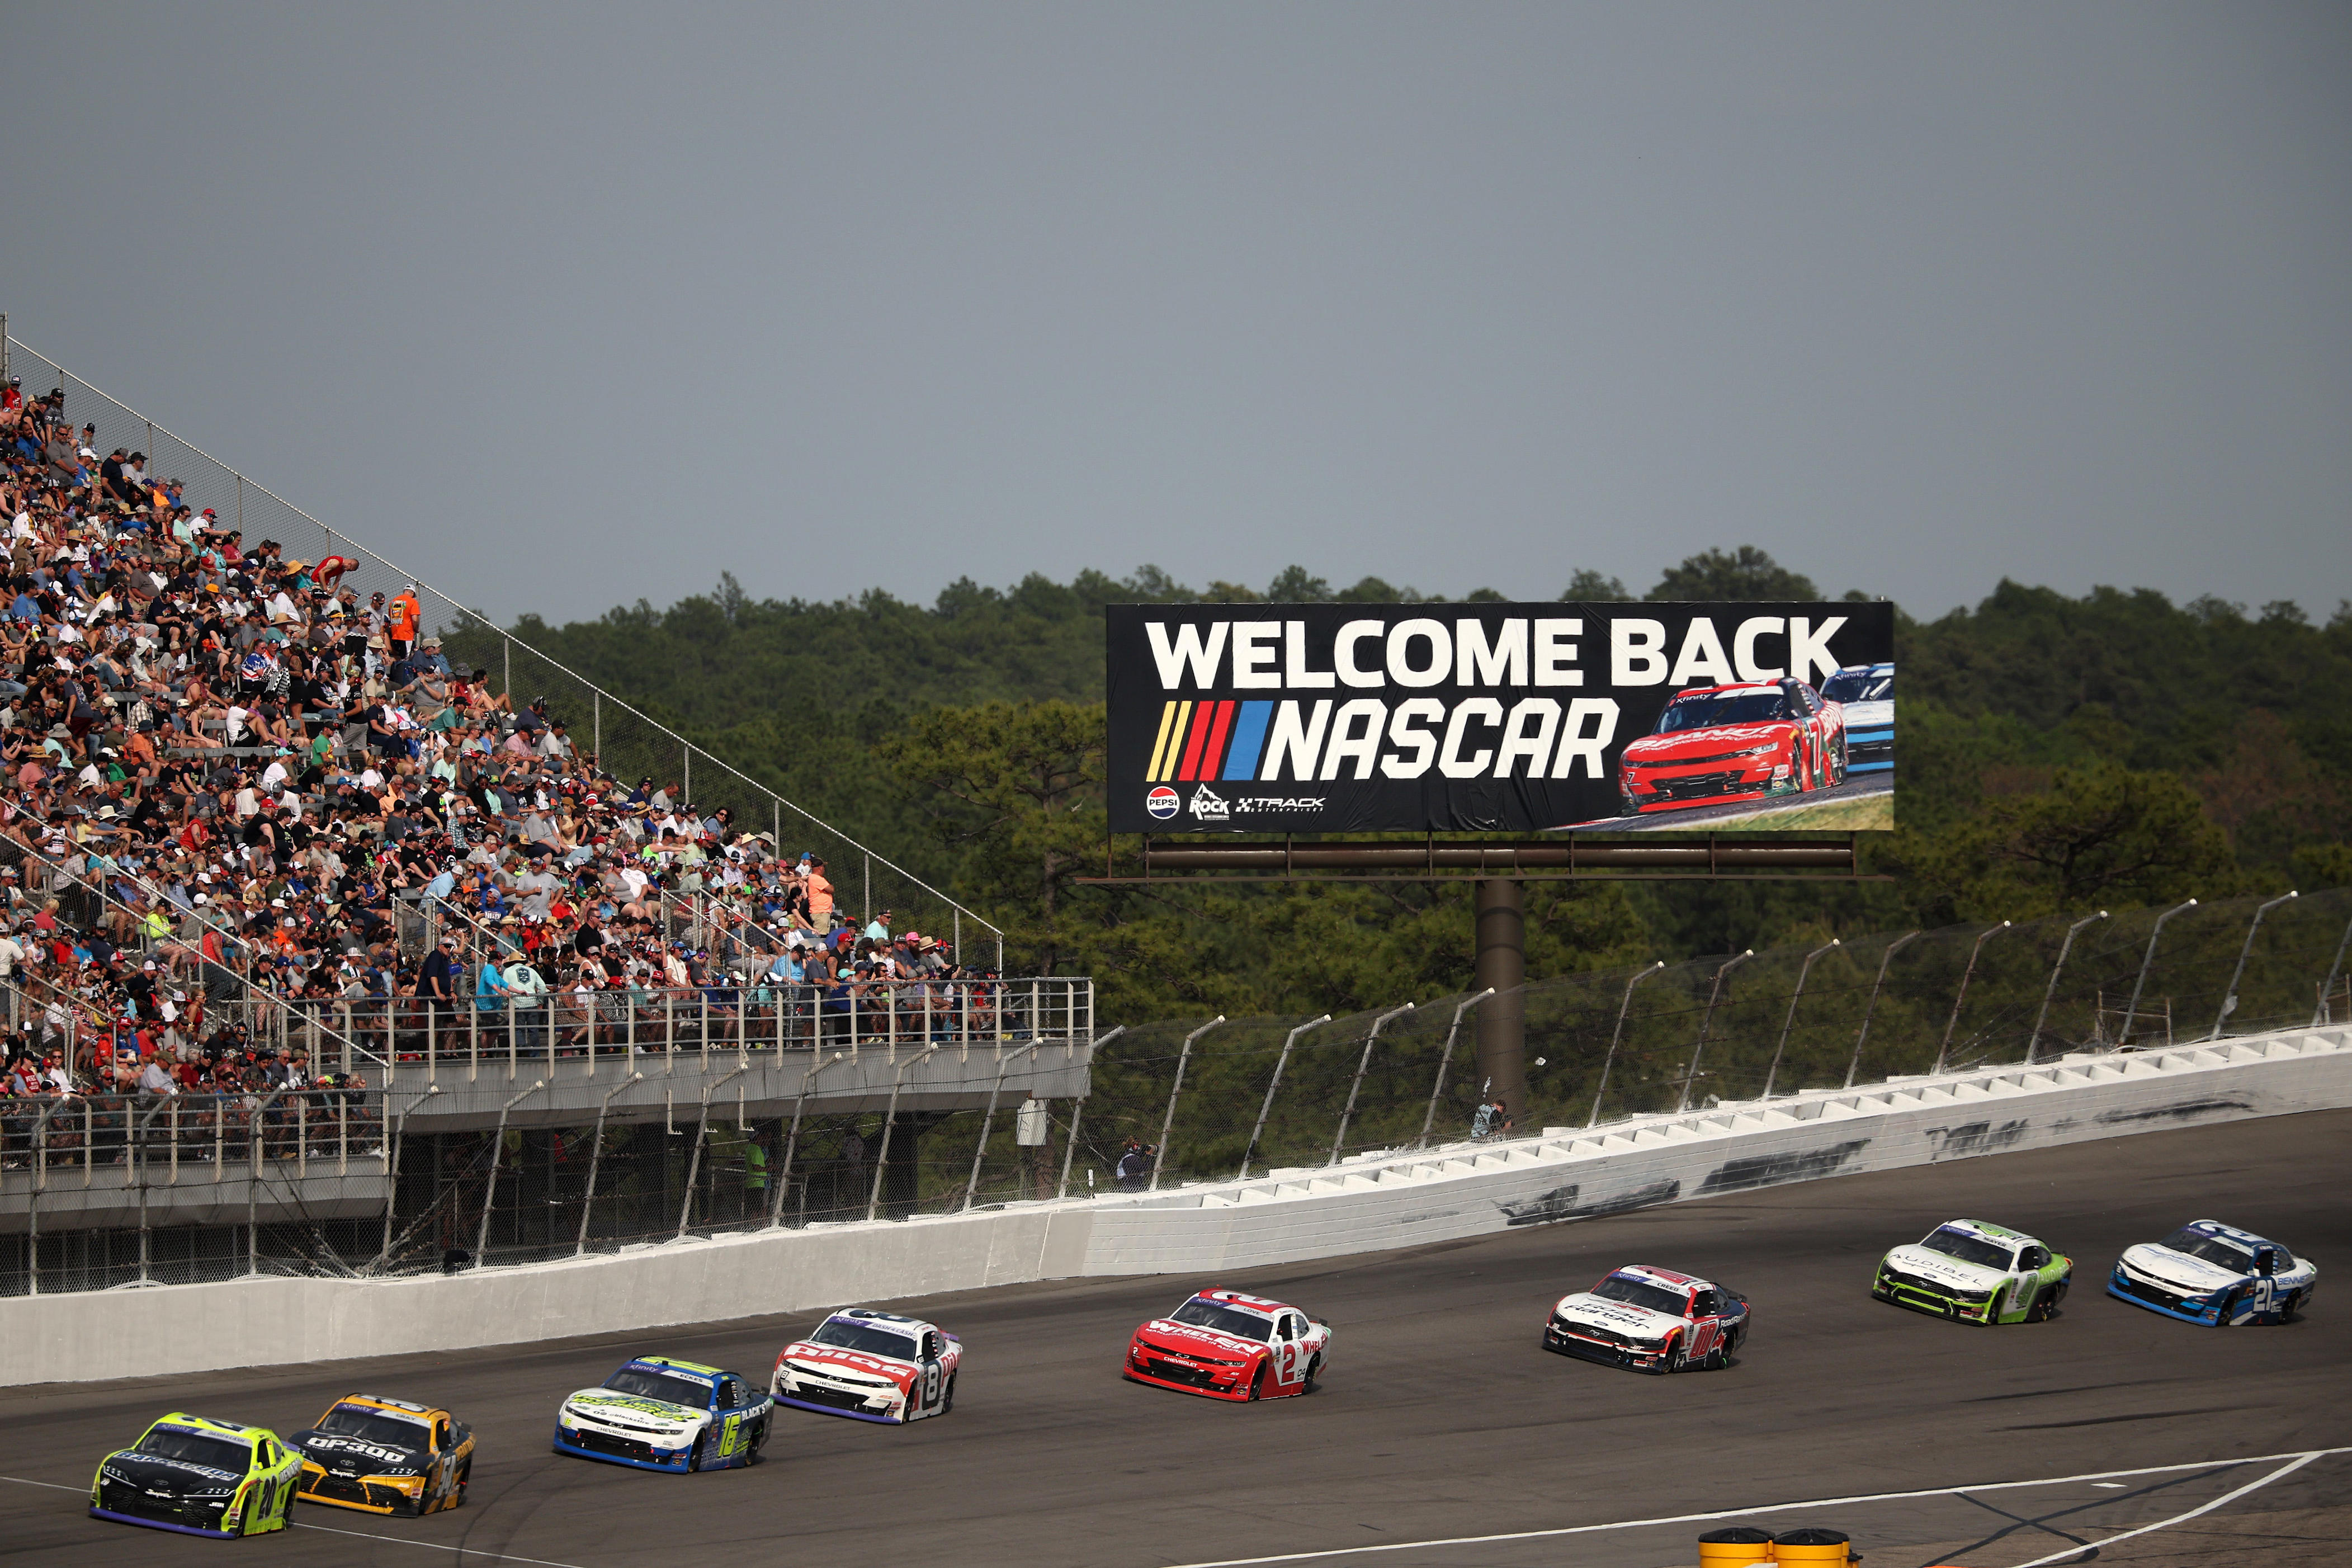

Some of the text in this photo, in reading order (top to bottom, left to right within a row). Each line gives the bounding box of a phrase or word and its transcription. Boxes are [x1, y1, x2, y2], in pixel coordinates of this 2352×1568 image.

[1145, 616, 1848, 689] WELCOME BACK
[1260, 697, 1621, 781] NASCAR
[1627, 772, 1635, 783] 7
[1254, 797, 1327, 807] TRACK
[1188, 800, 1230, 820] ROCK
[1890, 1254, 1982, 1287] AUDIBEL
[1617, 1273, 1642, 1281] xfinity
[1657, 1282, 1679, 1292] CREED
[1197, 1297, 1222, 1306] xfinity
[2253, 1279, 2273, 1312] 21
[1564, 1305, 1650, 1329] Ranger
[1582, 1303, 1647, 1321] Road
[835, 1316, 864, 1325] xfinity
[1720, 1316, 1735, 1328] Road
[872, 1323, 891, 1331] DASH
[896, 1329, 914, 1337] CASH
[1145, 1328, 1207, 1342] MANUFACTURED
[1217, 1344, 1250, 1358] AMERICA
[1149, 1320, 1264, 1354] WHELEN
[1689, 1321, 1718, 1360] 00
[1132, 1346, 1139, 1355] 2
[1163, 1356, 1198, 1368] CHEVROLET
[1281, 1344, 1296, 1383] 2
[630, 1364, 659, 1373] xfinity
[679, 1373, 703, 1383] ECKES
[780, 1371, 789, 1379] 8
[815, 1380, 851, 1390] CHEVROLET
[924, 1362, 942, 1405] 8
[342, 1403, 373, 1412] xfinity
[742, 1404, 766, 1421] BLACK'S
[160, 1423, 192, 1432] xfinity
[596, 1426, 632, 1438] CHEVROLET
[716, 1411, 741, 1460] 16
[329, 1468, 357, 1478] Supra
[257, 1473, 278, 1522] 20
